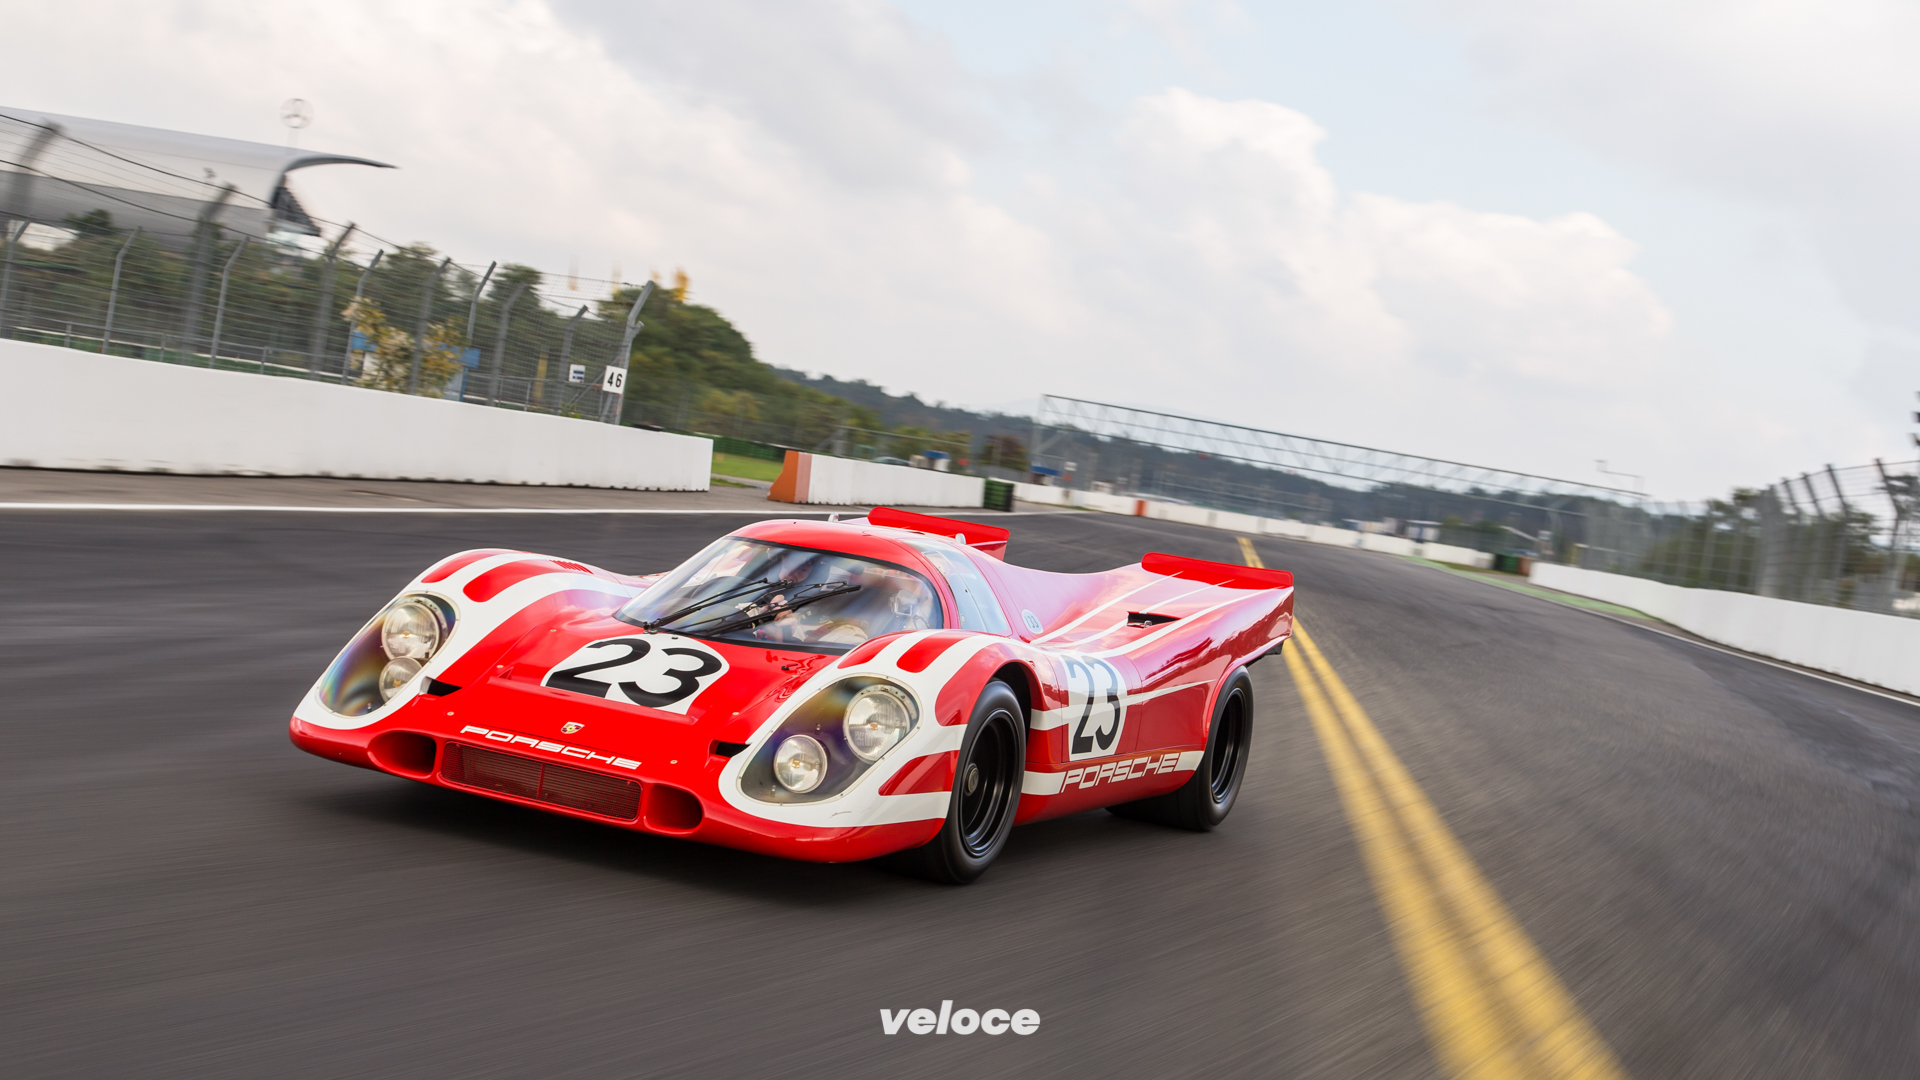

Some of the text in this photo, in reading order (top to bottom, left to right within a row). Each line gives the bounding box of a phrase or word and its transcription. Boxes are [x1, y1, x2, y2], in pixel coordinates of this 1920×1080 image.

[607, 372, 623, 388] 46
[546, 638, 722, 708] 23
[1060, 654, 1121, 755] 23
[460, 725, 642, 770] PORSCHE
[1061, 753, 1180, 793] PORSCHE
